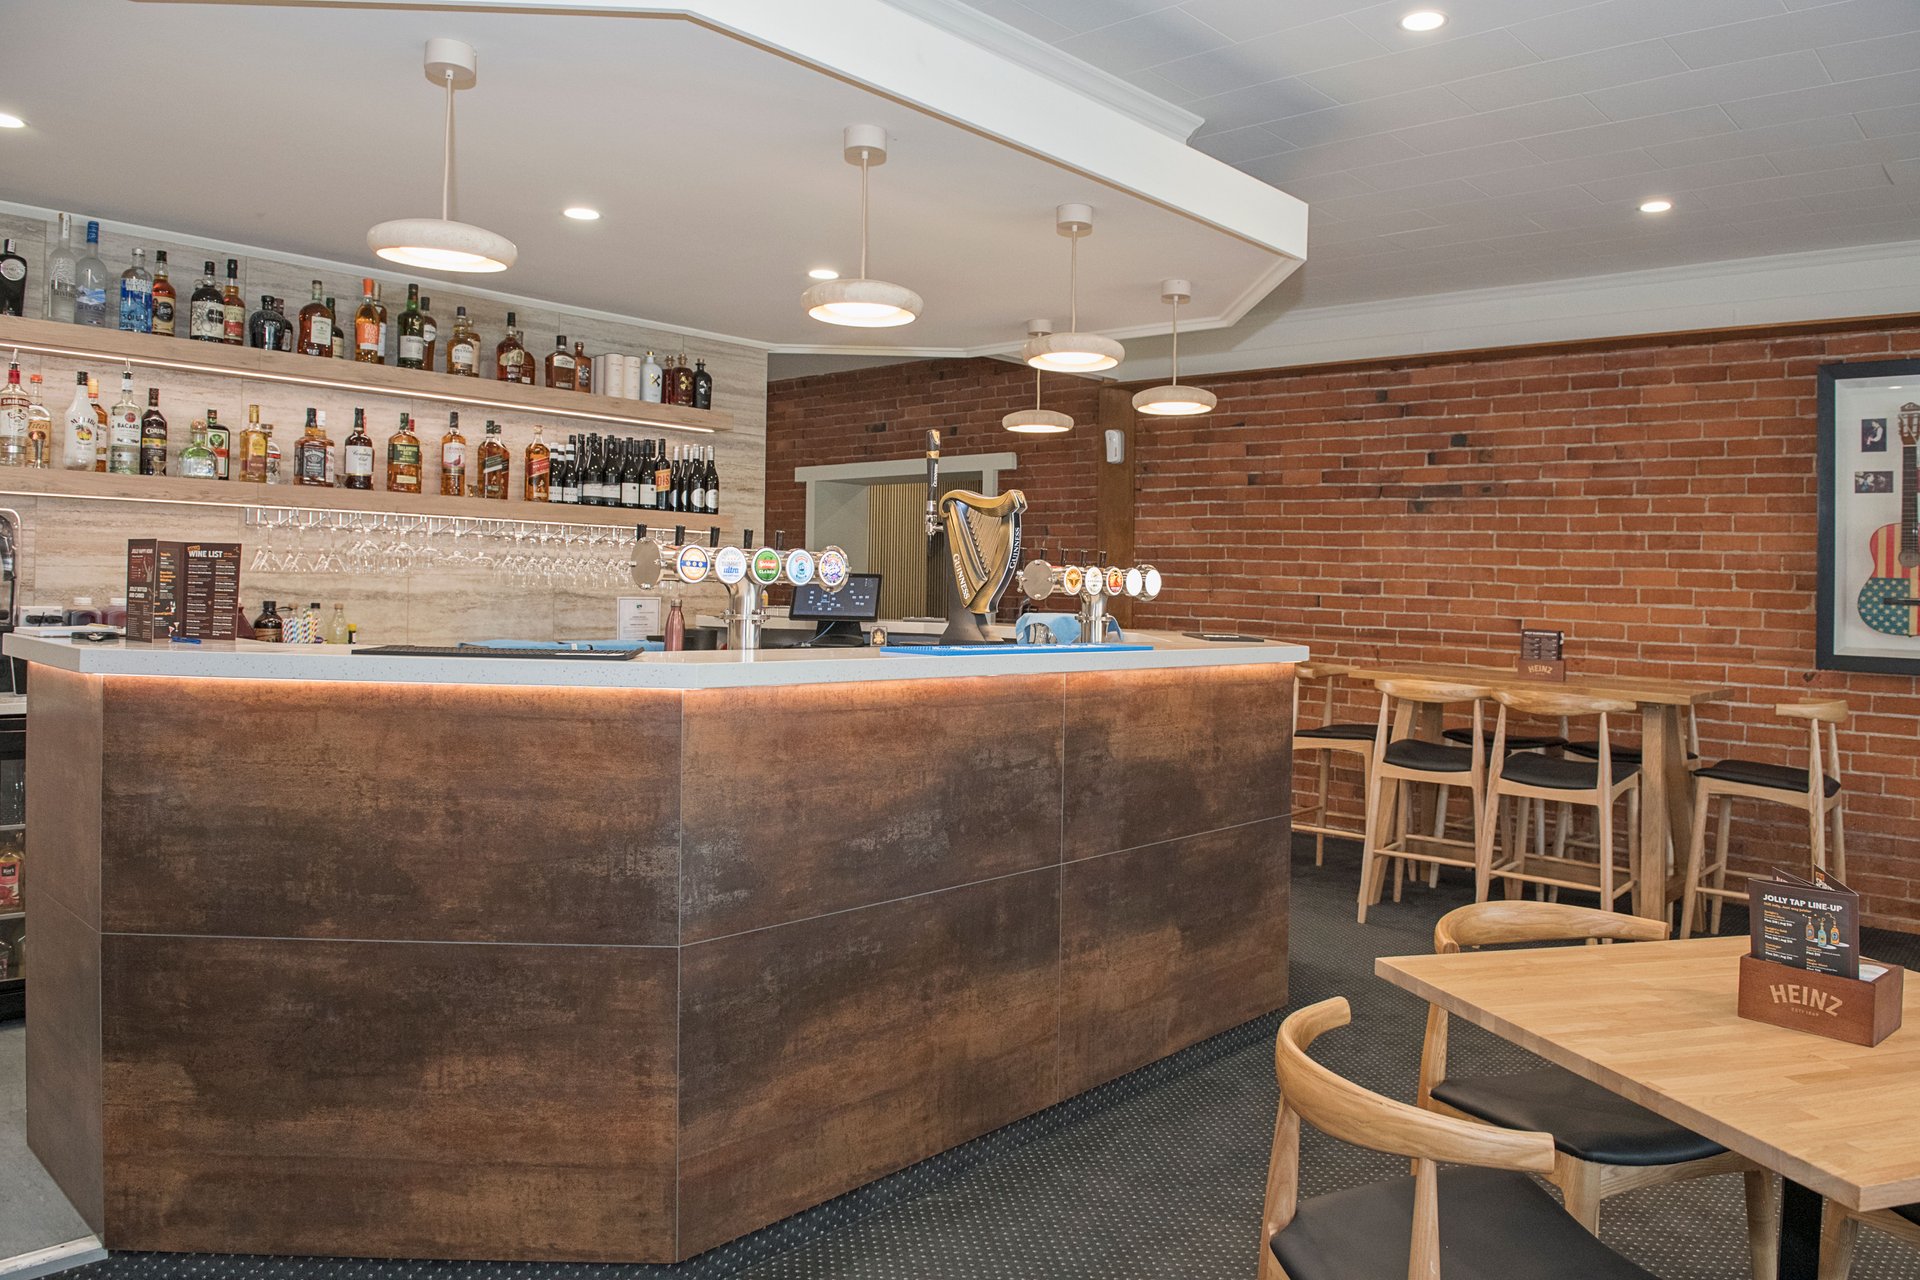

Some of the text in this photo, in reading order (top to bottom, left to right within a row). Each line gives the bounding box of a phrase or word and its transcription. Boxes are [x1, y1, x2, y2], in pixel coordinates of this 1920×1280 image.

[188, 550, 223, 558] WINE LIST
[1009, 527, 1021, 570] GUINNESS
[953, 553, 971, 600] GUINNESS
[1527, 664, 1553, 674] HEINZ
[1763, 894, 1788, 904] JOLLY
[1789, 898, 1806, 907] TAP
[1807, 901, 1843, 912] LINE-UP
[1769, 984, 1843, 1017] HEINZ
